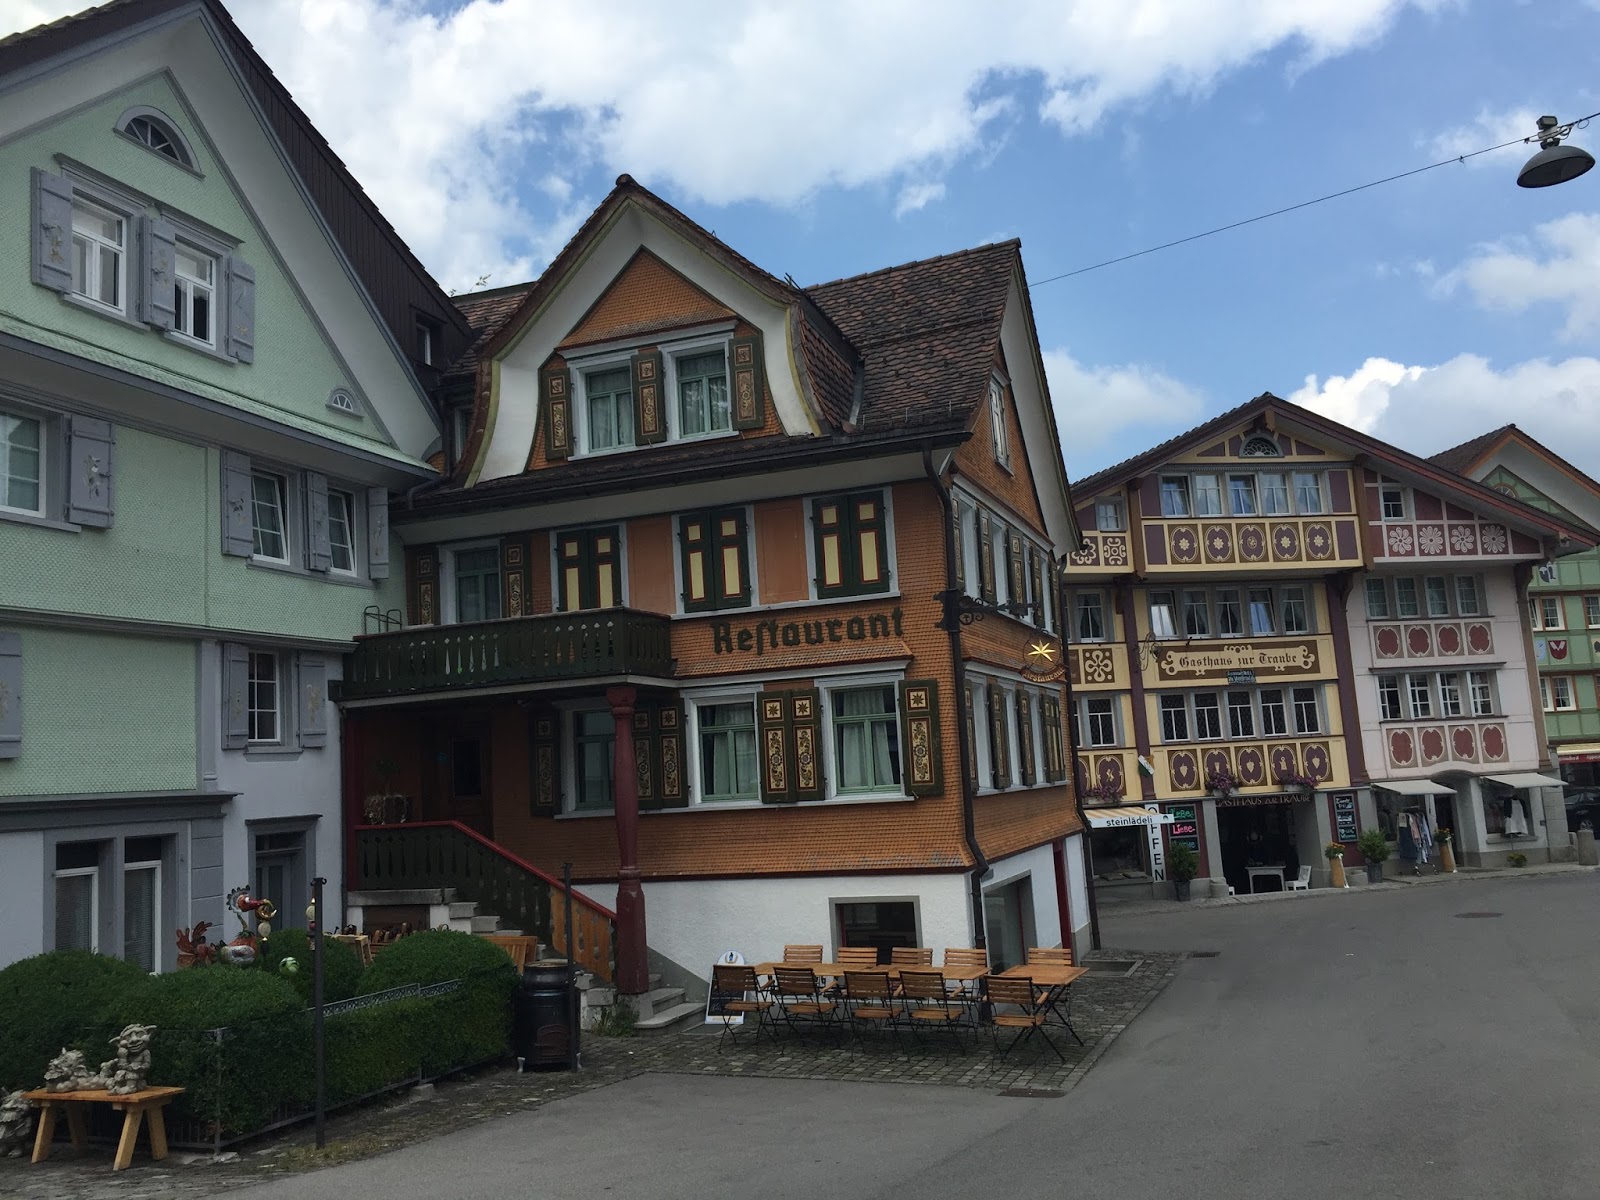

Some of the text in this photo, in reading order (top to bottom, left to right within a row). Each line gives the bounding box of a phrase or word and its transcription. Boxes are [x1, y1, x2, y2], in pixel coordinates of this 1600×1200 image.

[1180, 652, 1297, 668] Gasthaus zur Traube
[1106, 815, 1153, 827] steinlädeli
